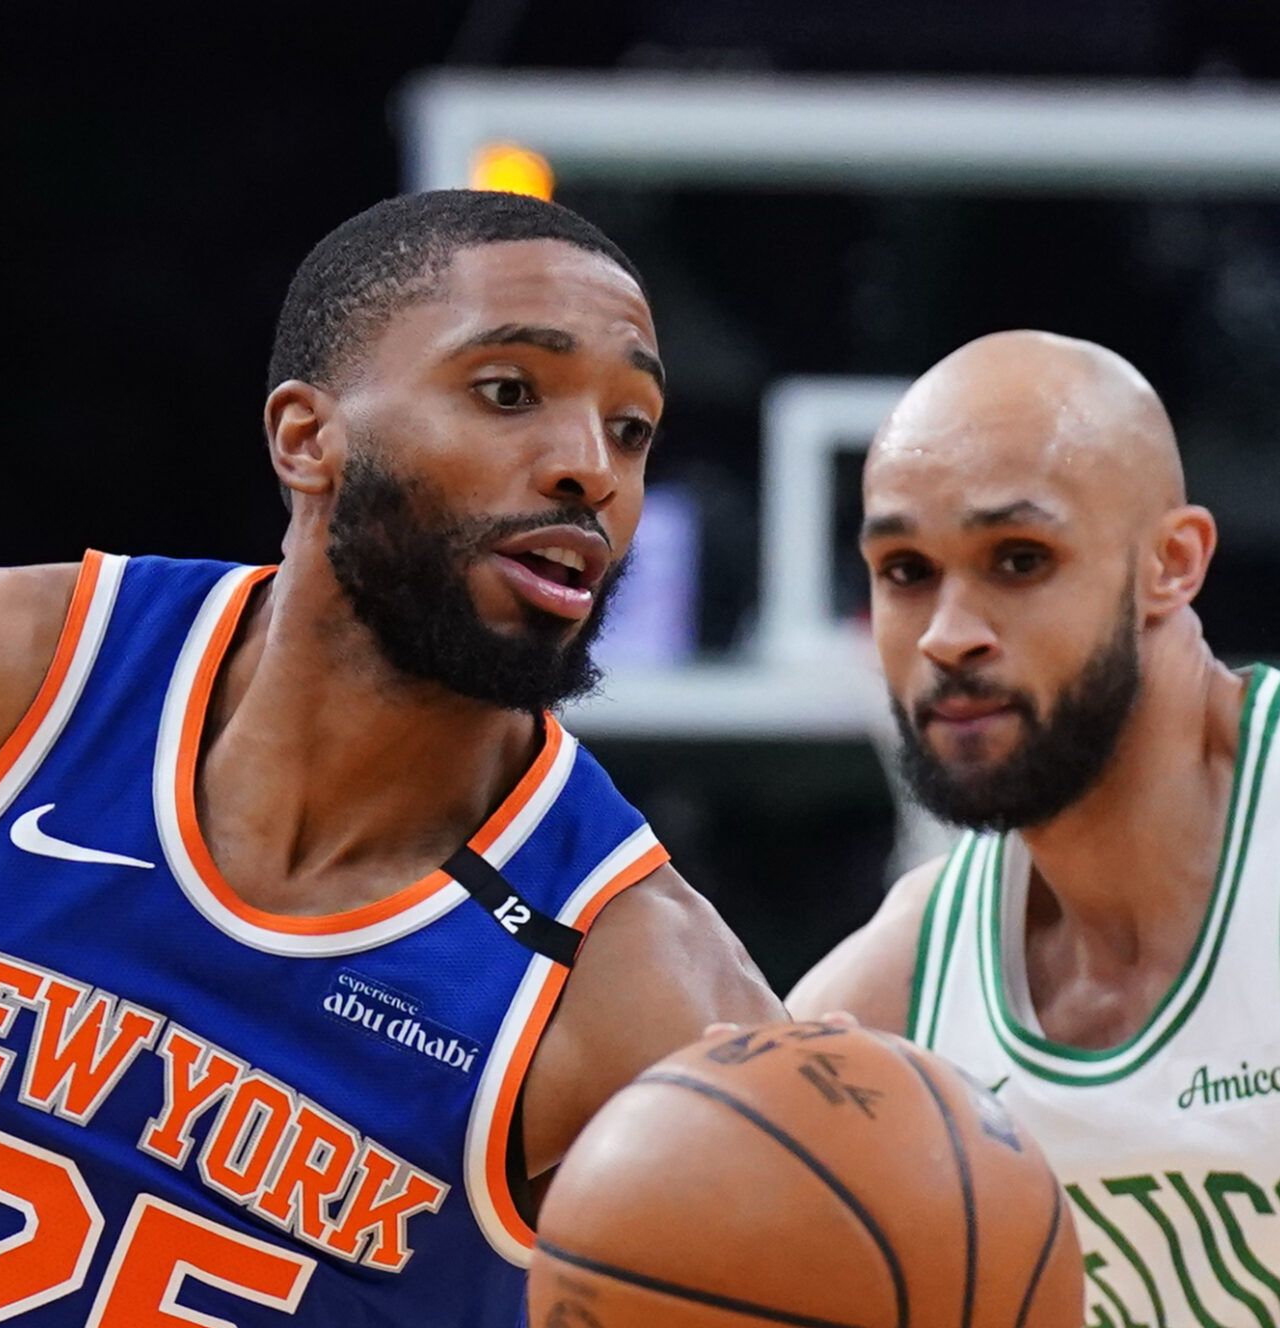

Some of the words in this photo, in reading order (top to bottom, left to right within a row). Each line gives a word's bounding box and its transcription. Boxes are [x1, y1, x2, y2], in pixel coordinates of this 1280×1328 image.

[493, 896, 531, 934] 12
[338, 973, 419, 1016] experience
[323, 992, 385, 1032] abu
[386, 1018, 479, 1073] dhabi
[137, 1019, 450, 1273] YORK
